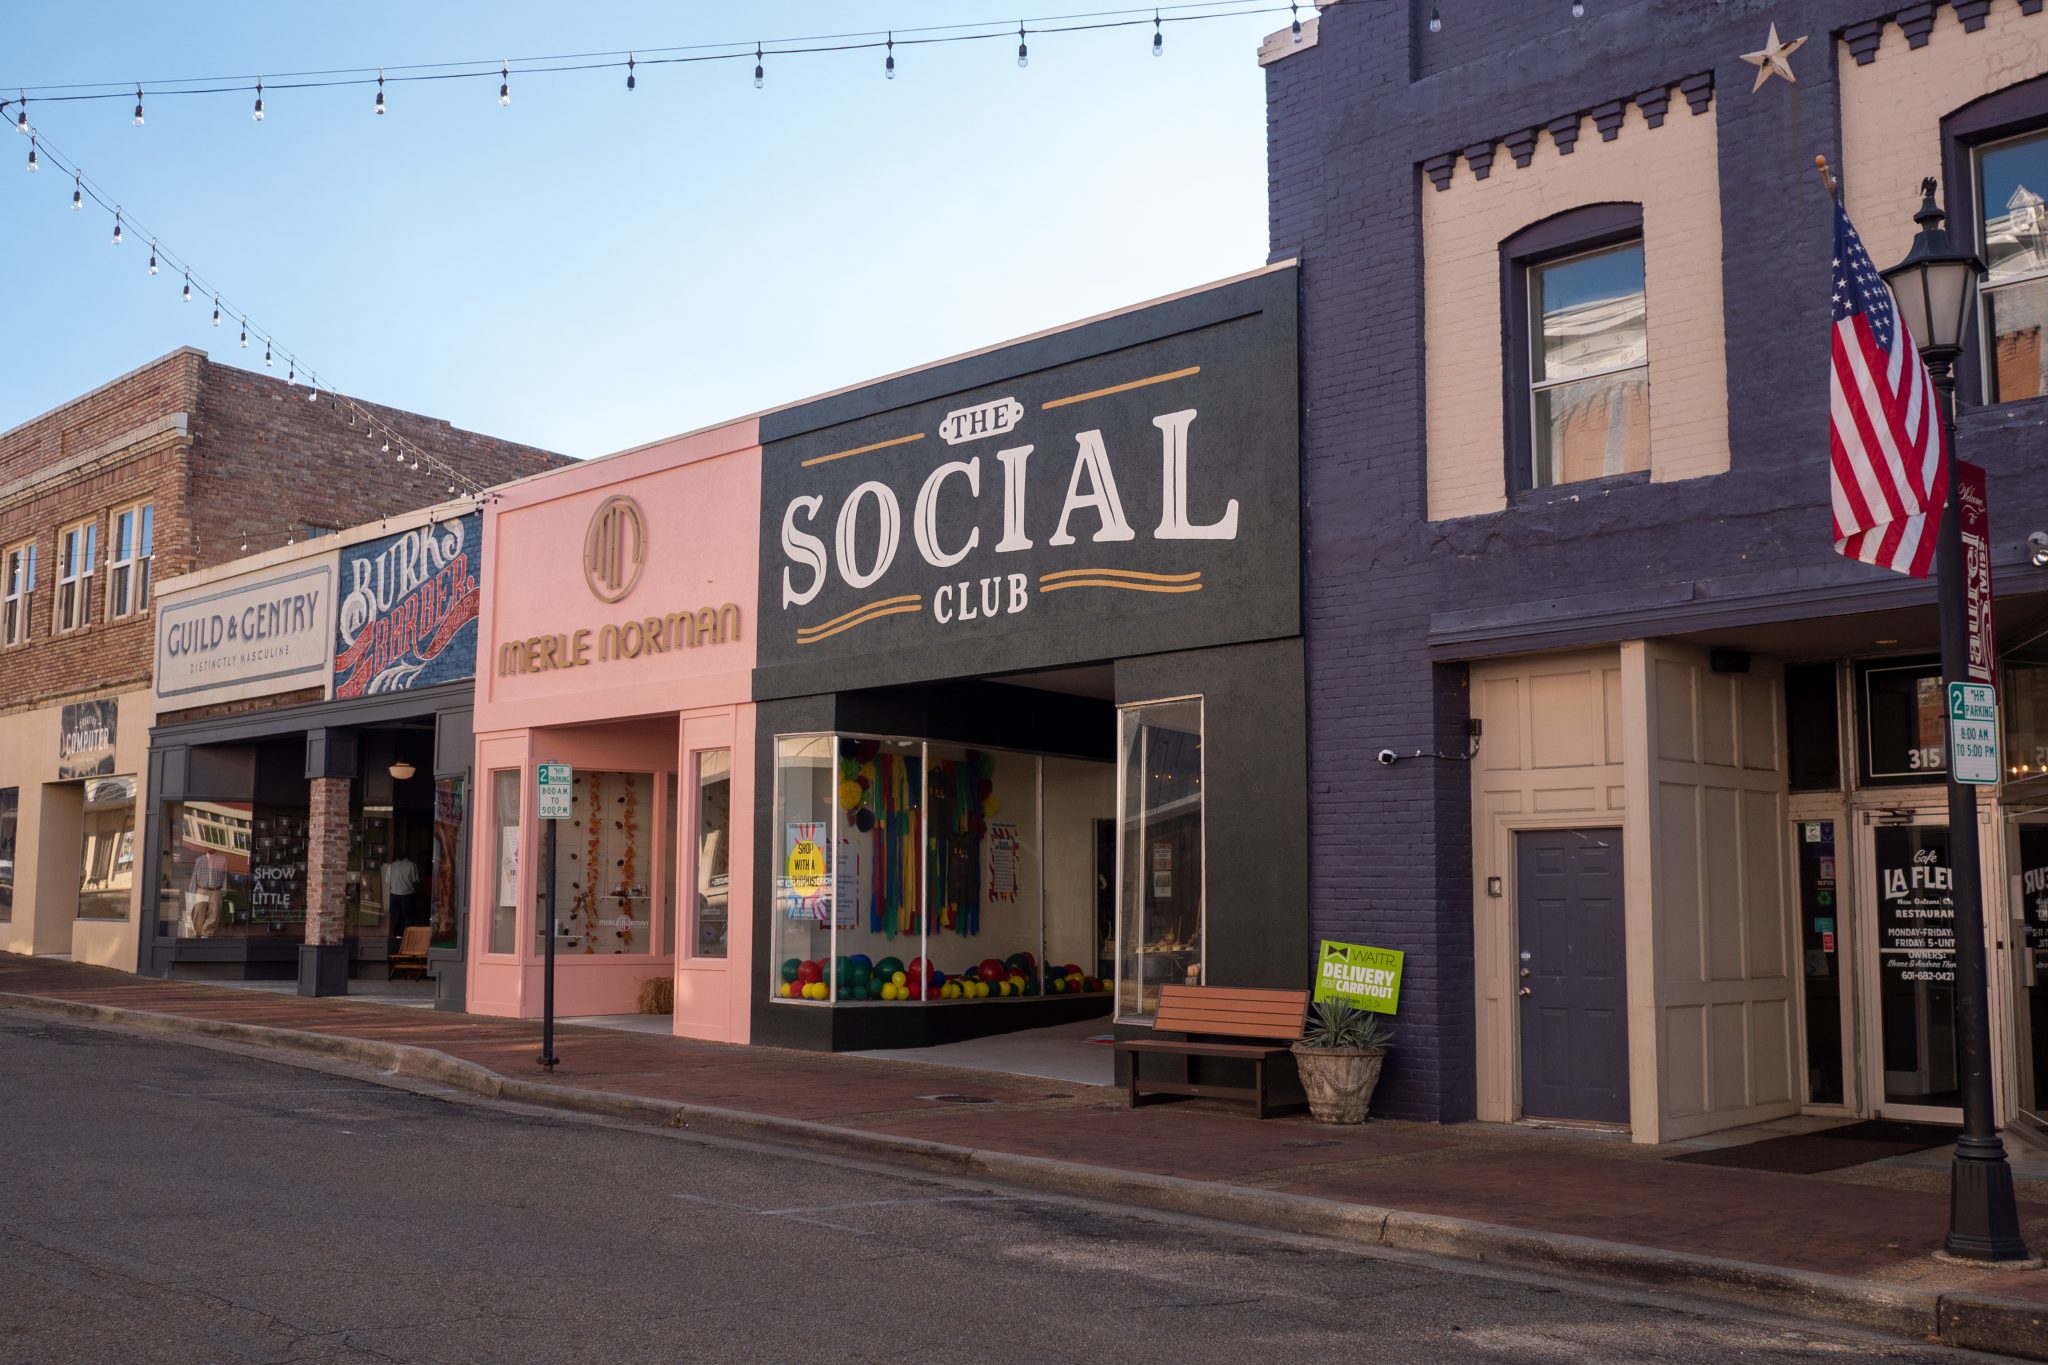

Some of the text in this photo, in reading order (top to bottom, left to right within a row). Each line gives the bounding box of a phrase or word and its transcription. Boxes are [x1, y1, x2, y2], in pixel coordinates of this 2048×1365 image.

[951, 404, 1009, 439] THE
[781, 408, 1239, 611] SOCIAL
[340, 518, 464, 645] BURKS
[933, 573, 1029, 625] CLUB
[168, 590, 319, 657] GUILD & GENTRY
[498, 602, 741, 678] MERLE NORMAN
[190, 644, 290, 674] DISTINCTLY MASCULINE
[1953, 690, 1964, 714] 2
[1966, 705, 1993, 718] PARKING
[66, 728, 109, 755] COMPUTER
[1961, 728, 1989, 741] 8:00 AM
[1908, 748, 1941, 769] 315
[1957, 744, 1995, 758] TO 5:00 PM
[540, 768, 548, 782] 2
[798, 842, 814, 855] SHOP
[794, 859, 815, 871] WITH A
[254, 867, 296, 880] SHOW
[253, 881, 264, 893] A
[1884, 866, 1953, 900] LA FLE
[252, 893, 291, 906] LITTLE
[1896, 909, 1955, 918] RESTAURAN
[1895, 939, 1955, 947] FRIDAY: 5-UNT
[1908, 950, 1947, 959] OWNERS:
[1323, 961, 1395, 987] DELIVERY
[1901, 971, 1955, 981] 601-682-0421
[1335, 980, 1393, 999] CARRYOUT
